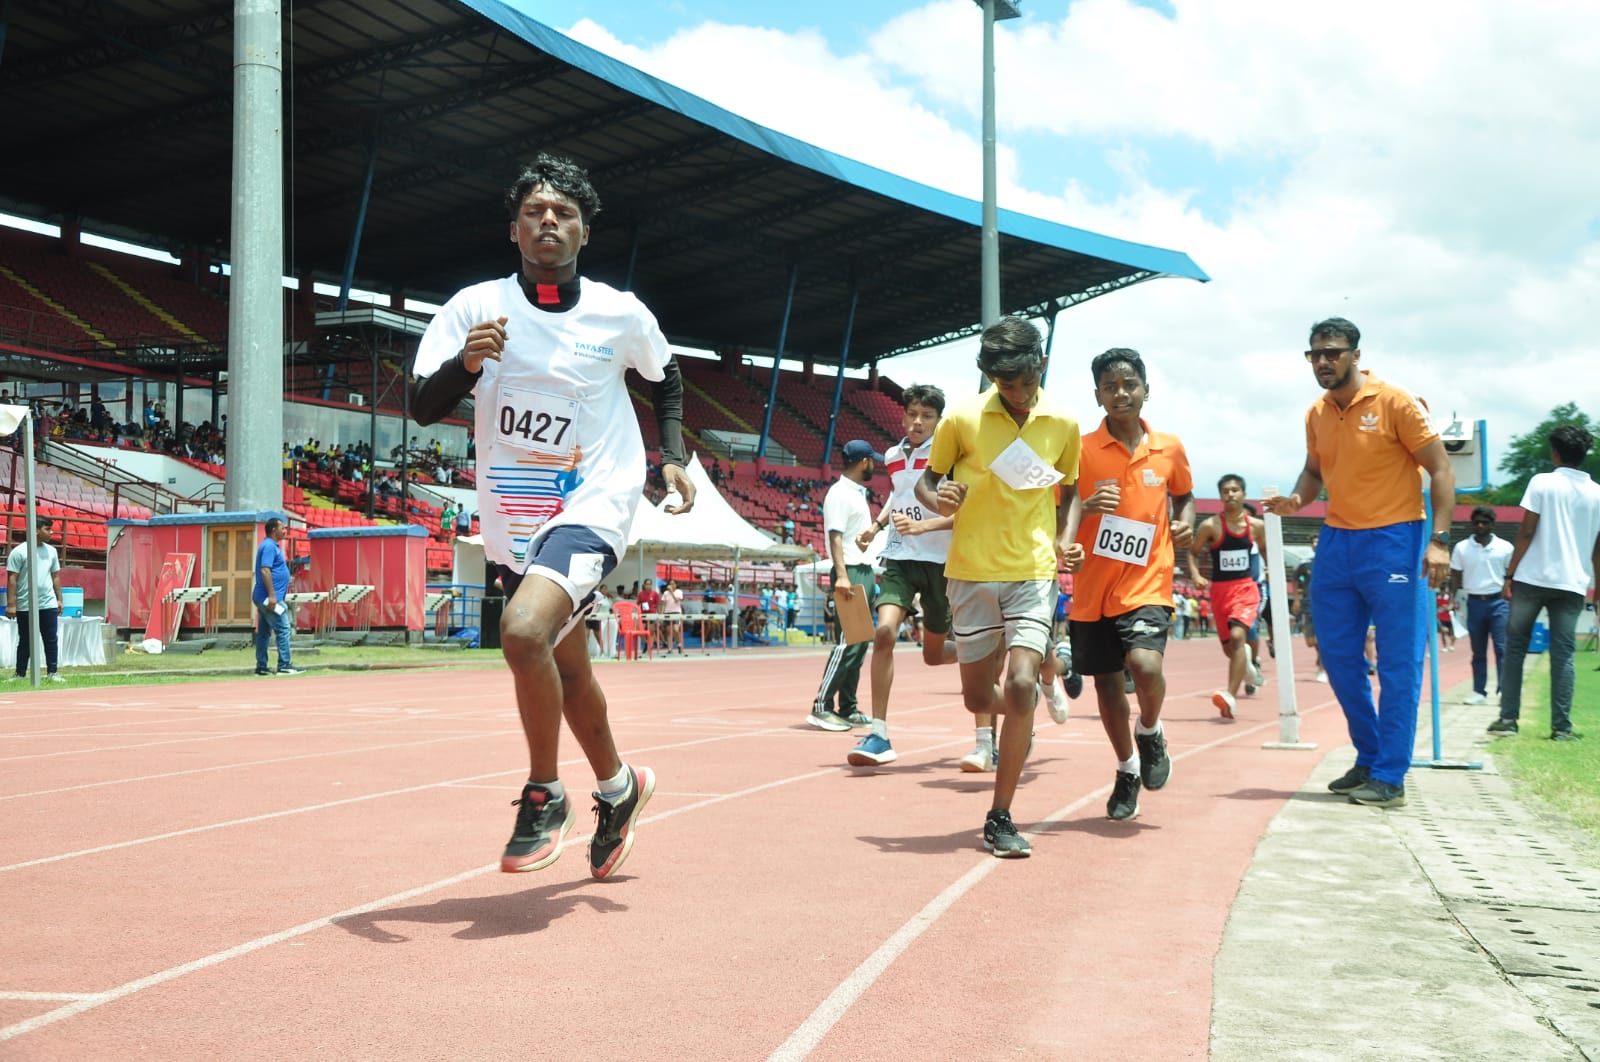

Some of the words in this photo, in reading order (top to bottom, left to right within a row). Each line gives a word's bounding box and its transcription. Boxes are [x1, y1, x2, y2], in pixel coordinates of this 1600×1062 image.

[575, 342, 597, 352] TATA
[500, 405, 572, 446] 0427
[1442, 421, 1464, 437] 4
[1099, 529, 1148, 558] 0360
[1222, 556, 1247, 568] 0447
